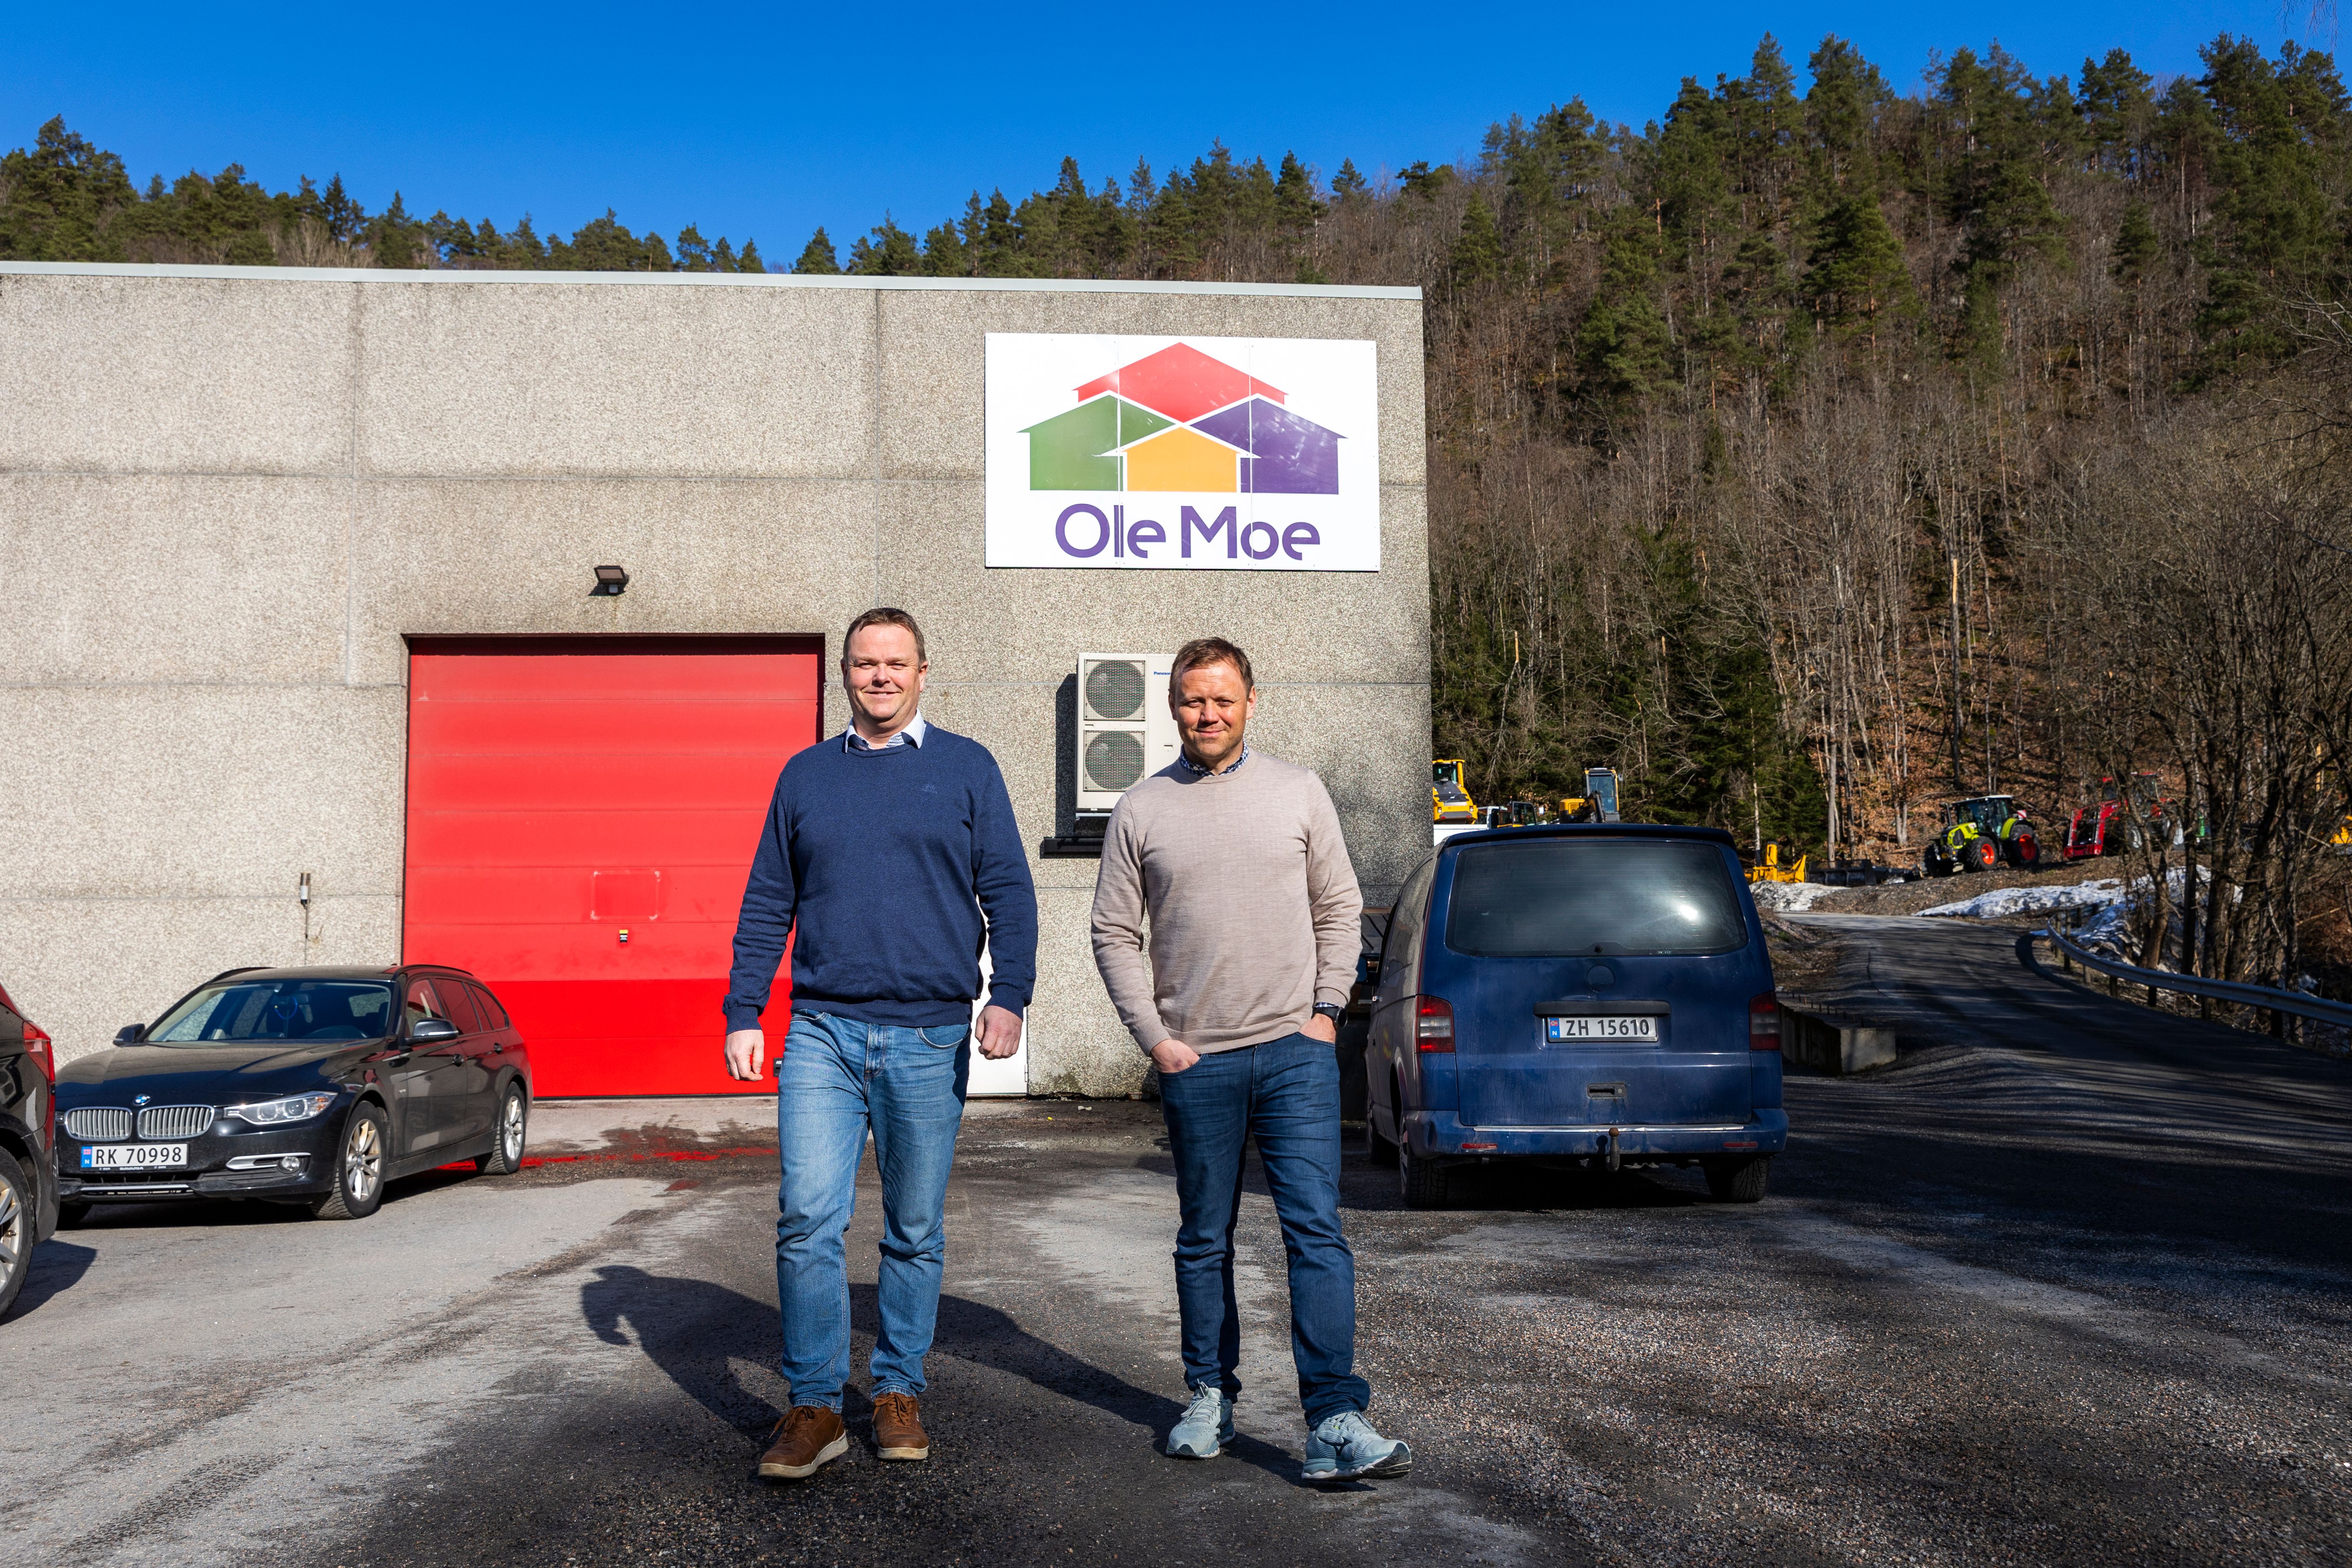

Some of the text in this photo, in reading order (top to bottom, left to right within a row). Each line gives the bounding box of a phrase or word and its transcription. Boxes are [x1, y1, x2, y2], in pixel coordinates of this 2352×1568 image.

[1055, 503, 1320, 561] Ole Moe
[1566, 1019, 1649, 1036] ZH 15610
[96, 1147, 182, 1164] RK 70998
